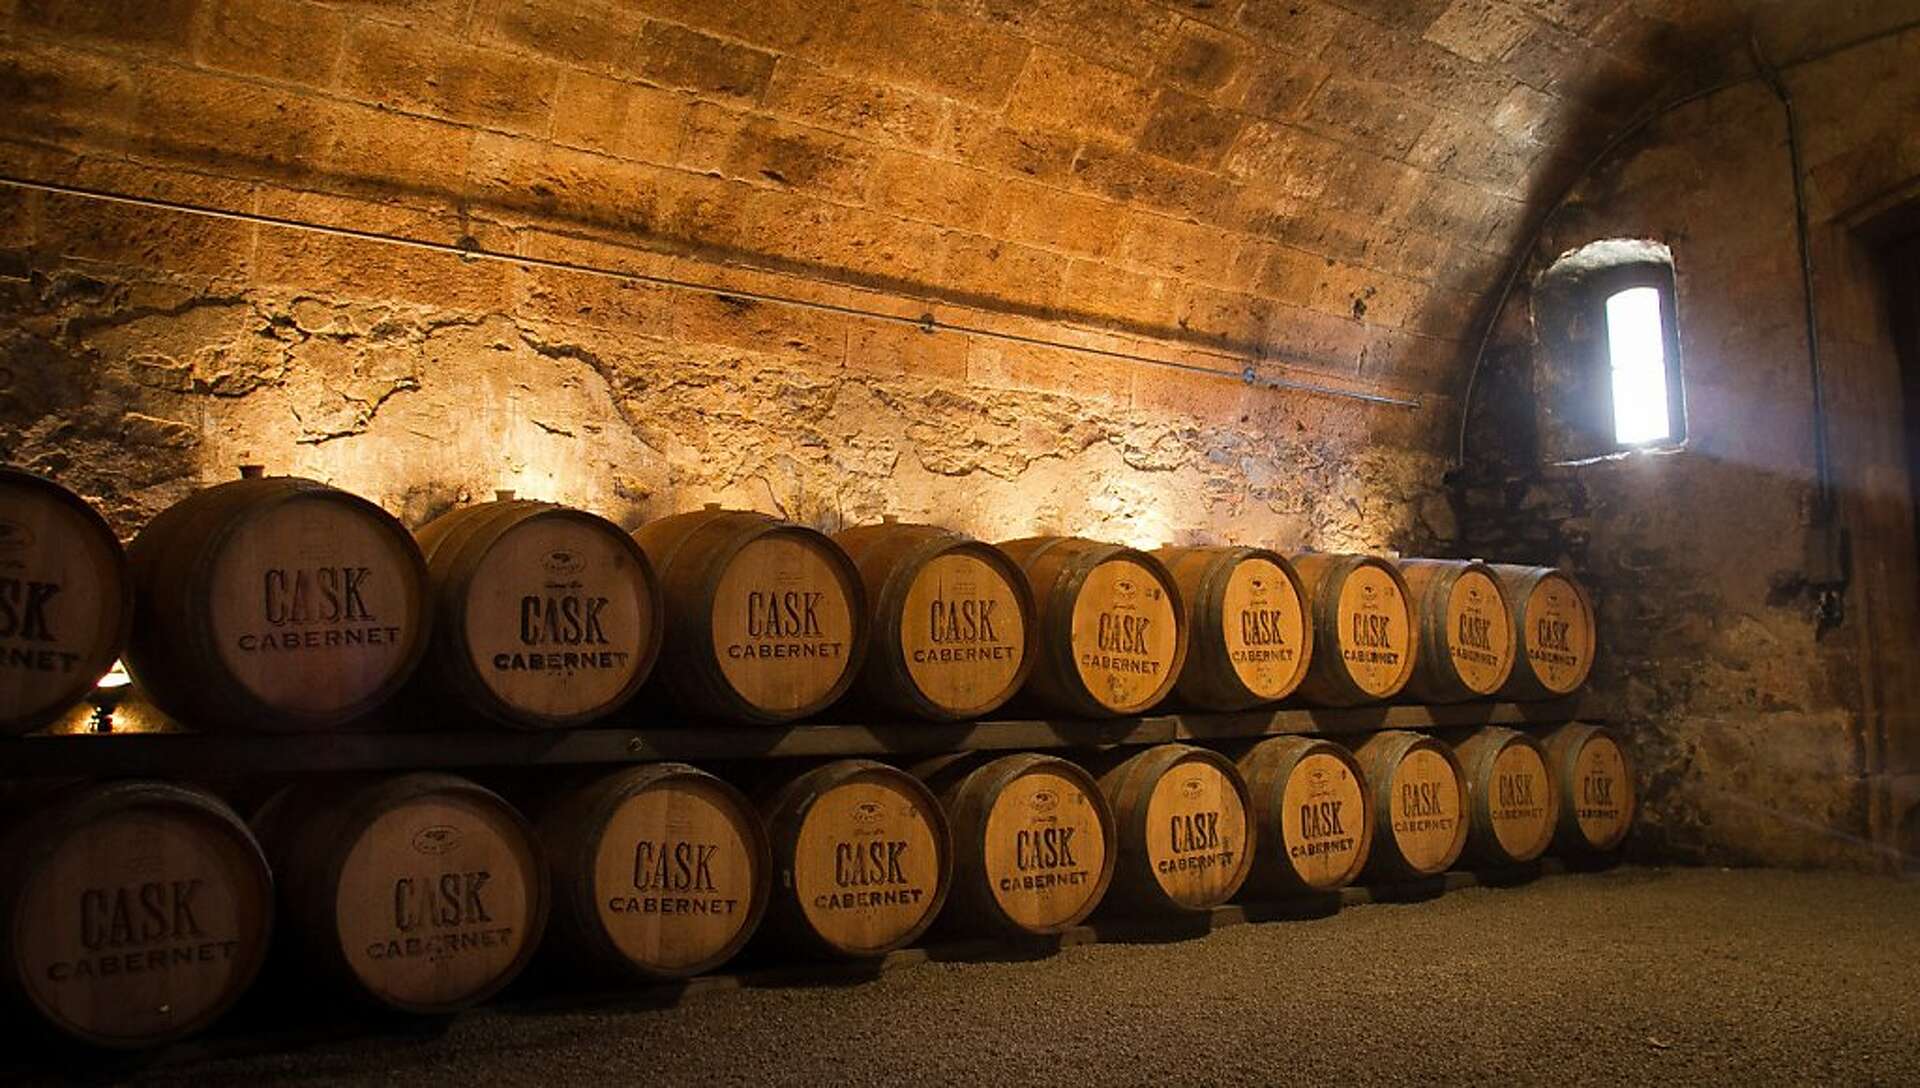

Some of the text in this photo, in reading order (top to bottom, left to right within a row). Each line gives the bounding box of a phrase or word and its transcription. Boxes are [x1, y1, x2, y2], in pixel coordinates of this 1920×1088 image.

[264, 566, 376, 626] CASK
[520, 595, 609, 645] CASK
[748, 591, 825, 638] CASK
[931, 599, 1000, 644] CASK
[1241, 609, 1284, 647] CASK
[1353, 613, 1391, 649] CASK
[1458, 613, 1491, 651] CASK
[238, 627, 401, 650] CABERNET
[727, 642, 842, 660] CABERNET
[1097, 611, 1150, 656] CASK
[1537, 618, 1570, 652] CASK
[493, 652, 629, 671] CABERNET
[913, 646, 1018, 663] CABERNET
[1081, 653, 1161, 674] CABERNET
[1231, 649, 1294, 664] CABERNET
[1343, 650, 1399, 665] CABERNET
[1402, 782, 1441, 817] CASK
[1499, 774, 1534, 808] CASK
[1583, 775, 1614, 806] CASK
[1171, 811, 1219, 854] CASK
[1301, 801, 1344, 840] CASK
[1394, 819, 1453, 833] CABERNET
[836, 840, 909, 888] CASK
[1017, 827, 1076, 871] CASK
[1291, 838, 1355, 859] CABERNET
[634, 840, 720, 893] CASK
[1000, 870, 1088, 891] CABERNET
[79, 878, 205, 951] CASK
[394, 871, 492, 933] CASK
[608, 897, 737, 916] CABERNET
[813, 888, 923, 910] CABERNET
[46, 940, 239, 982] CABERNET
[366, 928, 512, 960] CABERNET
